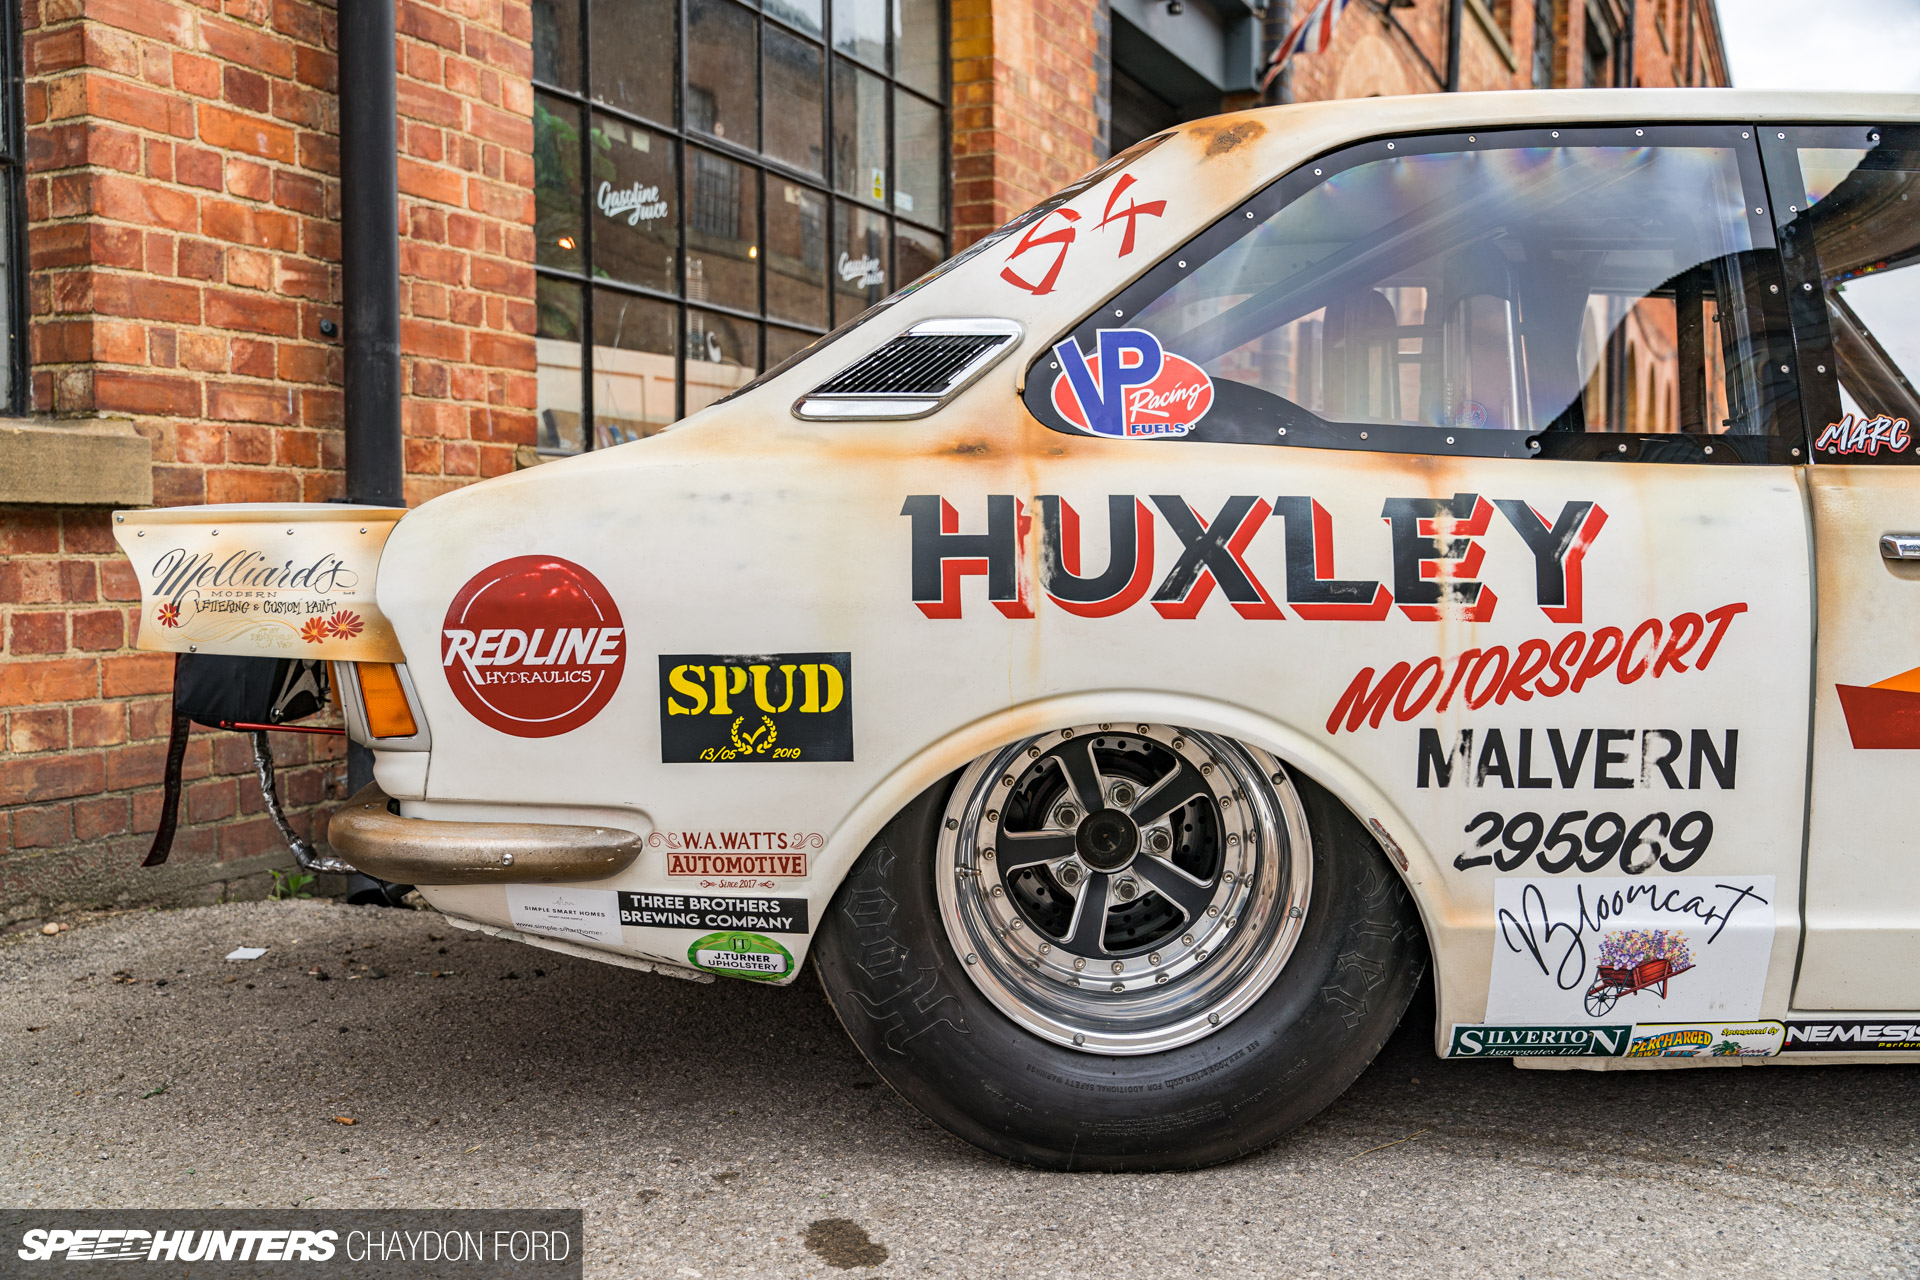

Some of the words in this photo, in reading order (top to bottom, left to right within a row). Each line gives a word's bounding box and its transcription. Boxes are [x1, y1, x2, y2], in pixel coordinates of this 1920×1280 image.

[597, 181, 659, 217] Gasoline
[627, 201, 668, 226] Juice
[1052, 328, 1165, 437] VP
[1129, 382, 1212, 422] Racing
[1131, 423, 1186, 434] FUELS
[1815, 412, 1911, 456] MARC
[899, 492, 1609, 624] HUXLEY
[211, 590, 277, 598] MODERN
[194, 599, 250, 614] LETTERING
[253, 603, 260, 611] &
[263, 600, 301, 615] CUSTOM
[305, 600, 337, 615] PAINT
[443, 627, 624, 685] REDLINE
[485, 669, 592, 684] HYDRAULICS
[1326, 602, 1748, 735] MOTORSPORT
[667, 663, 844, 716] SPUD
[699, 745, 737, 762] 13/05
[772, 747, 801, 759] 2019
[1416, 728, 1740, 790] MALVERN
[682, 831, 788, 850] W.A.WATTS
[1453, 810, 1714, 875] 295969
[670, 855, 802, 874] AUTOMOTIVE
[718, 879, 738, 889] Since
[739, 879, 757, 888] 2017
[524, 905, 550, 913] SIMPLE
[630, 894, 685, 910] THREE
[689, 897, 781, 914] BROTHERS
[620, 909, 701, 926] BREWING
[705, 914, 793, 930] COMPANY
[1499, 884, 1768, 990] Bloomcart
[708, 960, 778, 971] UPHOLSTERY
[714, 952, 770, 963] J.TURNER
[1721, 1026, 1767, 1036] Sponsored
[1786, 1024, 1920, 1042] NEMESI
[1456, 1029, 1626, 1056] SILVERTON
[1485, 1047, 1556, 1057] Aggregates
[1559, 1047, 1583, 1055] Ltd
